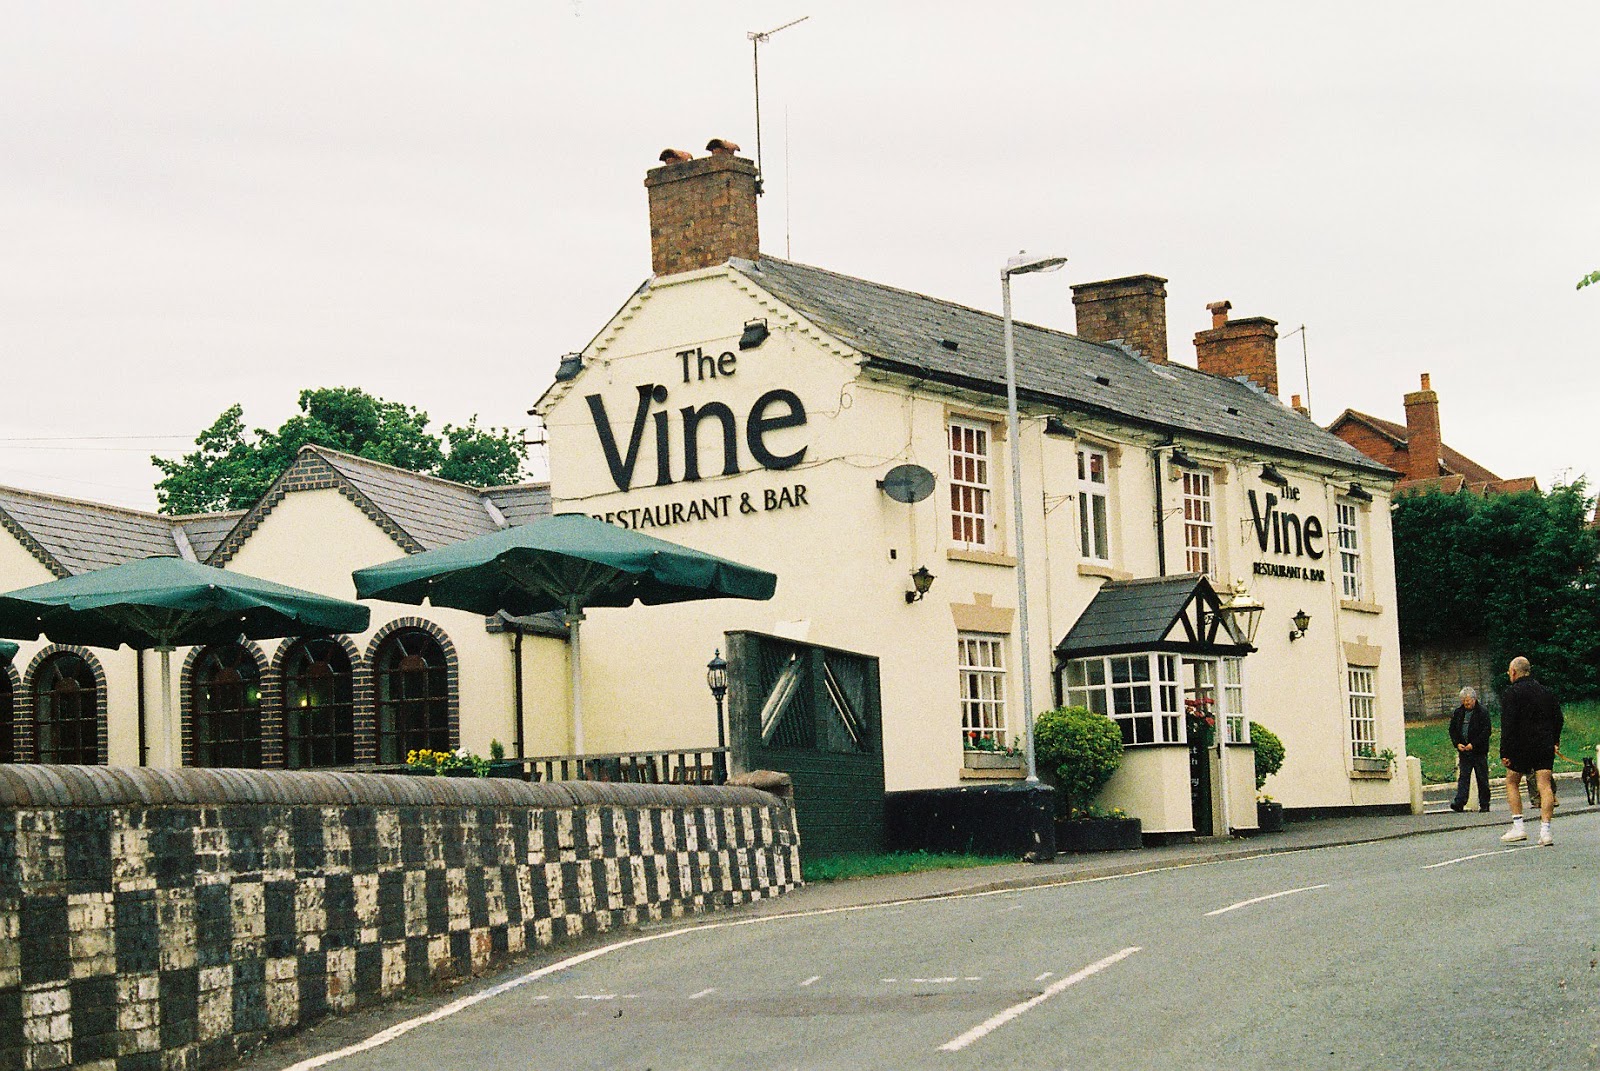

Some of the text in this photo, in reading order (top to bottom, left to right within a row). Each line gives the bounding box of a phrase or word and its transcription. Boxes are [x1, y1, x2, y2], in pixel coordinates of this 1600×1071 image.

[676, 347, 737, 382] The
[584, 383, 809, 492] Vine
[739, 492, 757, 514] &
[763, 484, 809, 511] BAR
[1247, 489, 1324, 560] Vine
[1253, 562, 1301, 579] RESTAURANT
[1310, 568, 1326, 582] BAR
